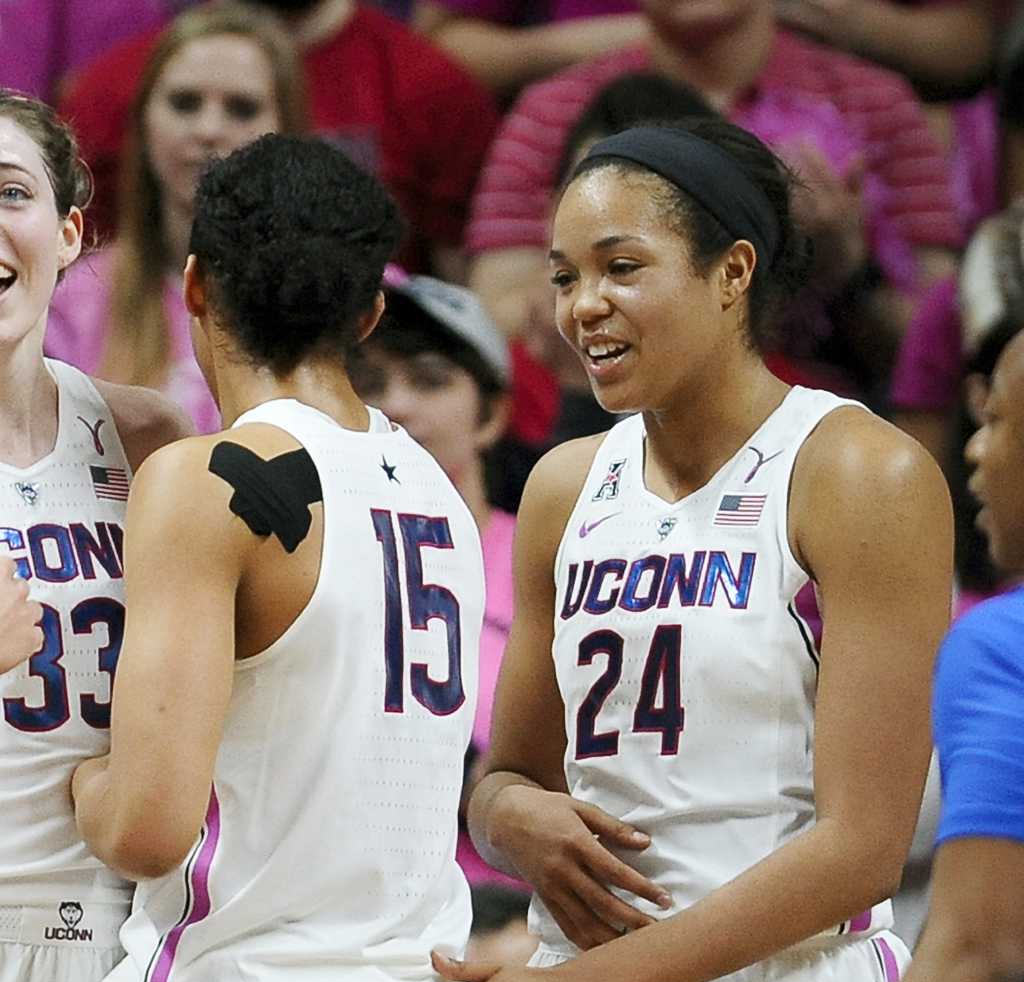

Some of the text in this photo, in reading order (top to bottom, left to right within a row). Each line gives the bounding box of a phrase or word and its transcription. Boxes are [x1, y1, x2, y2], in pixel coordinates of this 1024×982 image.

[370, 507, 466, 717] 15
[560, 550, 757, 620] UCONN
[2, 596, 126, 733] 33
[575, 624, 685, 761] 24
[44, 926, 93, 941] UCONN
